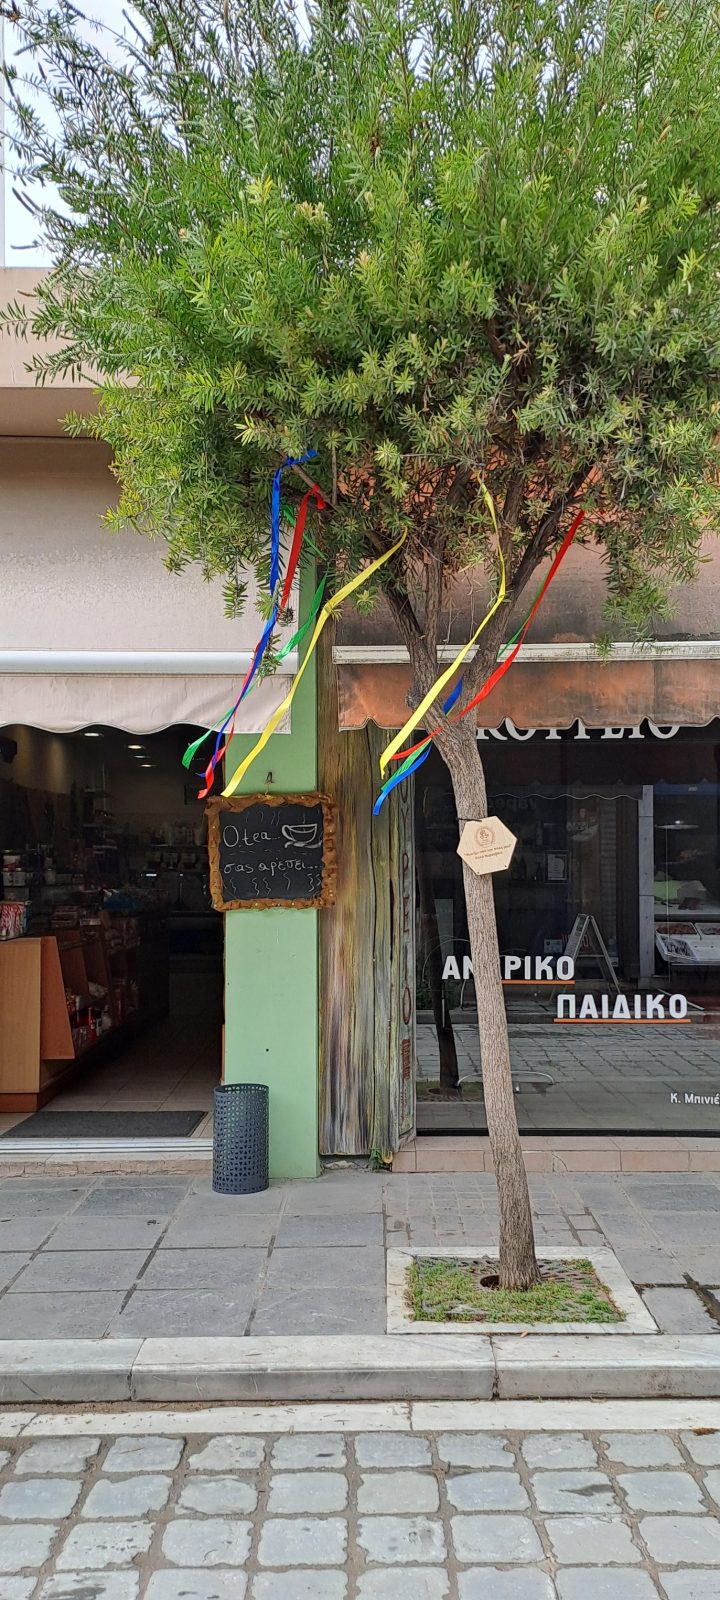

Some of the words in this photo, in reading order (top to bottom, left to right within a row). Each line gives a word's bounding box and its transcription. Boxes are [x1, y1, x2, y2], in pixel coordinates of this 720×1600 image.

[441, 955, 575, 981] ΑΝΡΙΚΟ
[557, 993, 688, 1019] ΠΑΙΔΙΚΟ
[670, 1092, 681, 1104] Κ.
